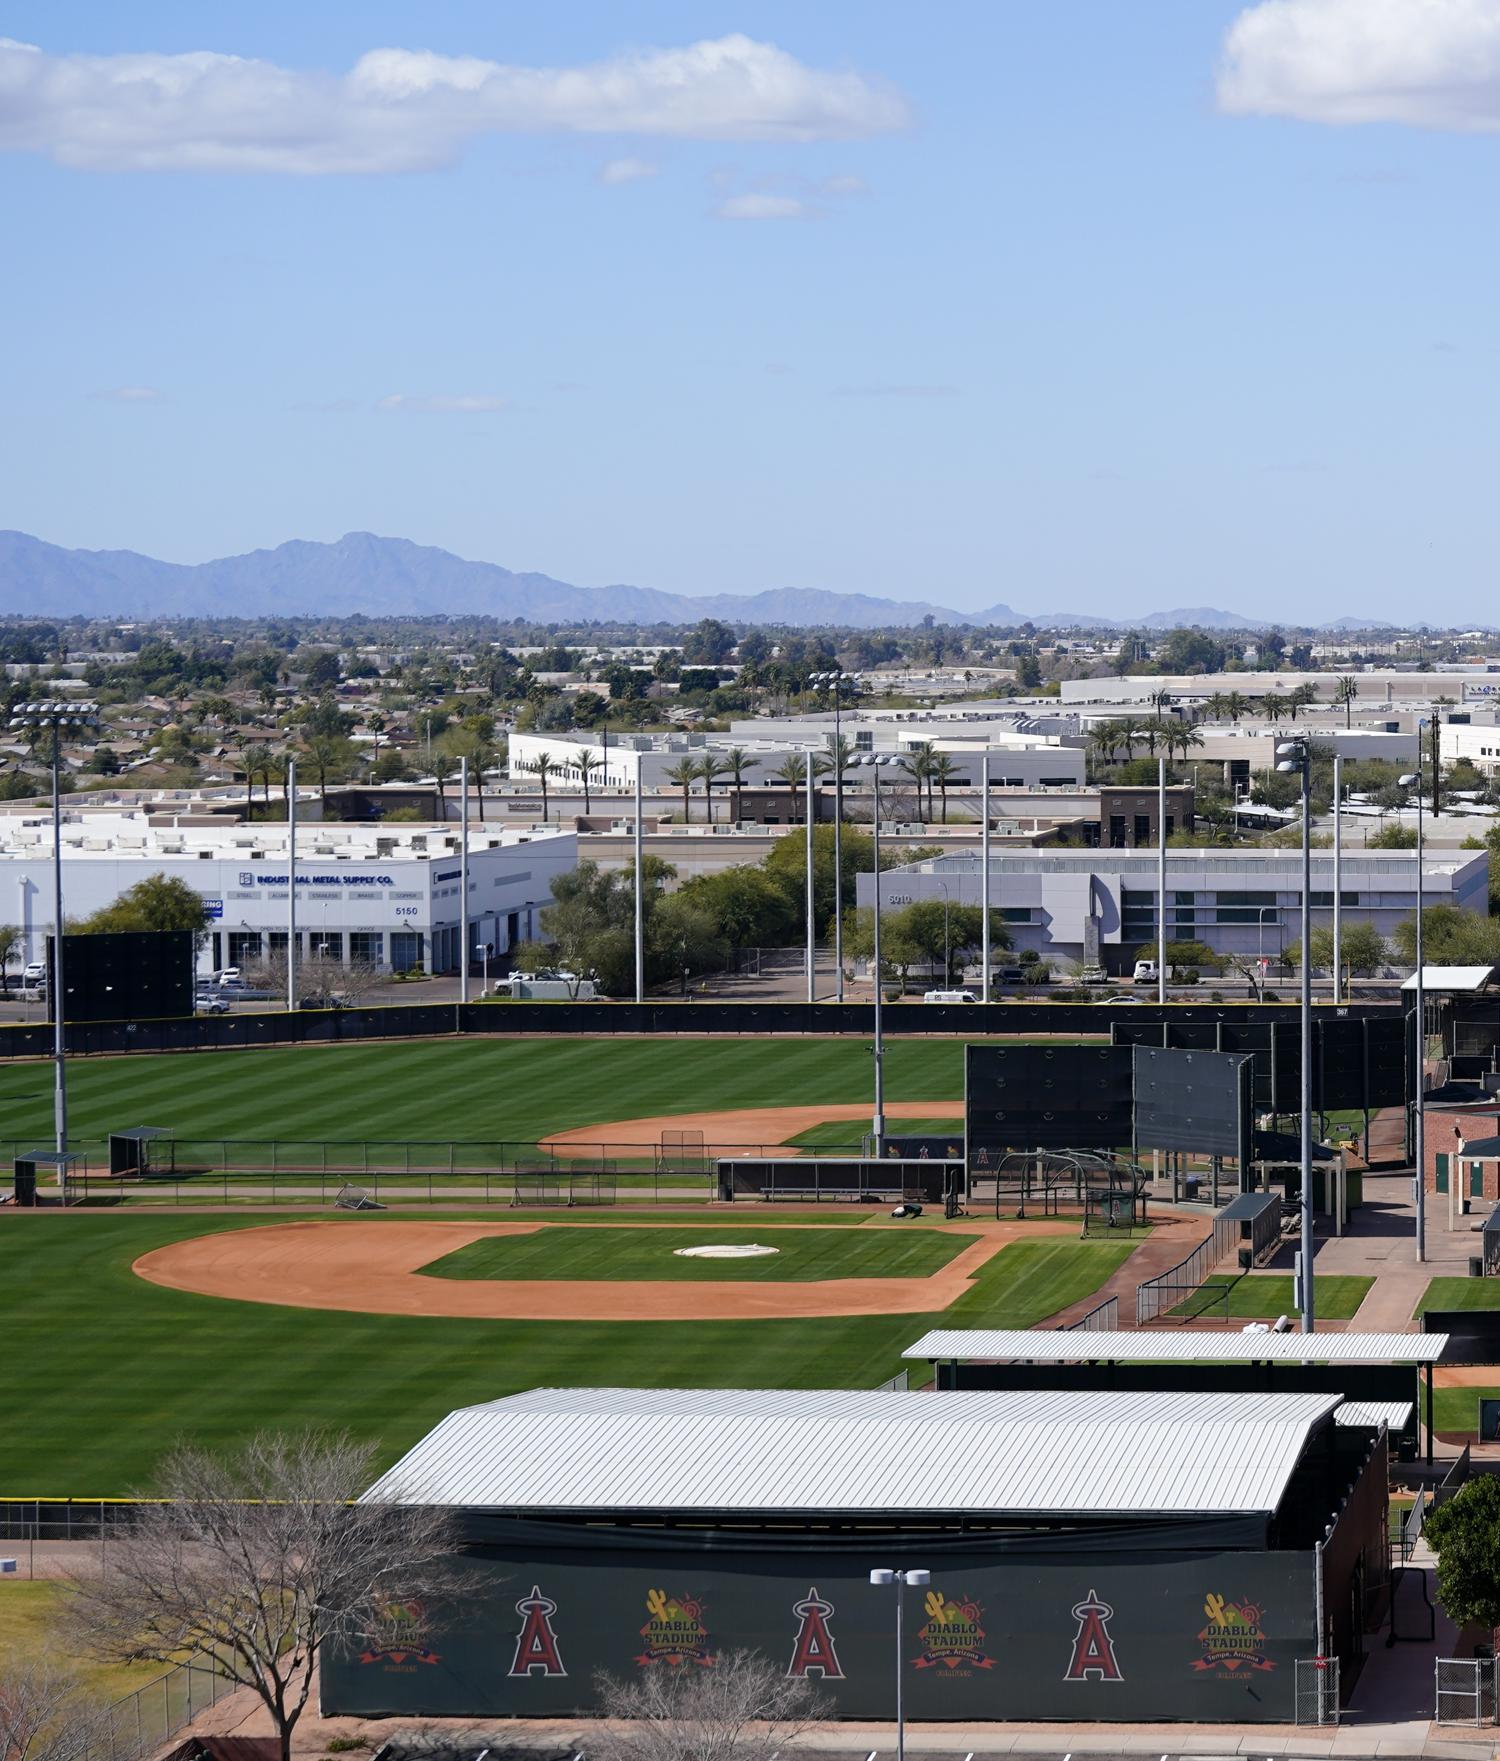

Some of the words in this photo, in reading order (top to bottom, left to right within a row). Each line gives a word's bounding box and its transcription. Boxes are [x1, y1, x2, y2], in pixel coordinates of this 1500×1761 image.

[257, 876, 310, 884] INDUSTIAL
[313, 876, 341, 884] METAL
[343, 876, 375, 884] SUPPLY
[377, 876, 393, 884] CO.
[395, 907, 418, 915] 5150
[507, 1585, 568, 1676] A
[650, 1621, 699, 1631] DIABLO
[928, 1623, 977, 1633] DIABLO
[1207, 1625, 1257, 1636] DIABLO
[644, 1633, 705, 1643] STADIUM
[785, 1587, 846, 1678] A
[1062, 1589, 1124, 1681] A
[923, 1636, 983, 1646] STADIUM
[1202, 1638, 1263, 1649] STADIUM
[953, 1648, 979, 1659] Arizona
[1233, 1650, 1259, 1662] Arizona
